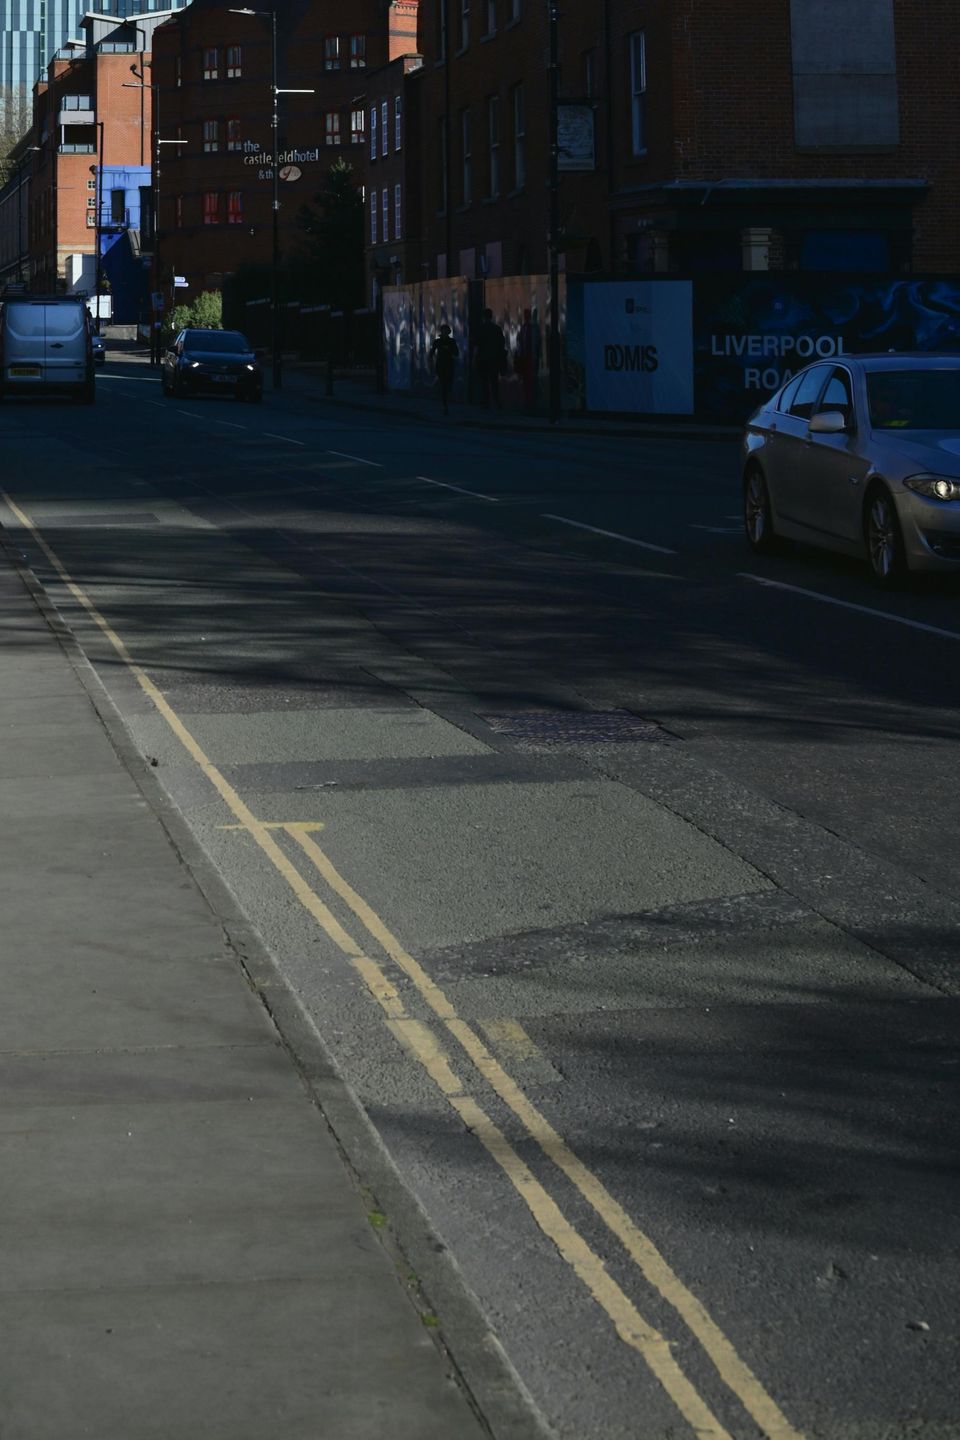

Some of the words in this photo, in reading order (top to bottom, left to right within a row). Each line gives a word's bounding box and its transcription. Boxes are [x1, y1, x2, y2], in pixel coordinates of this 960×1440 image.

[243, 140, 260, 153] the
[711, 334, 852, 357] LIVERPOOL
[604, 344, 658, 372] DOMIS
